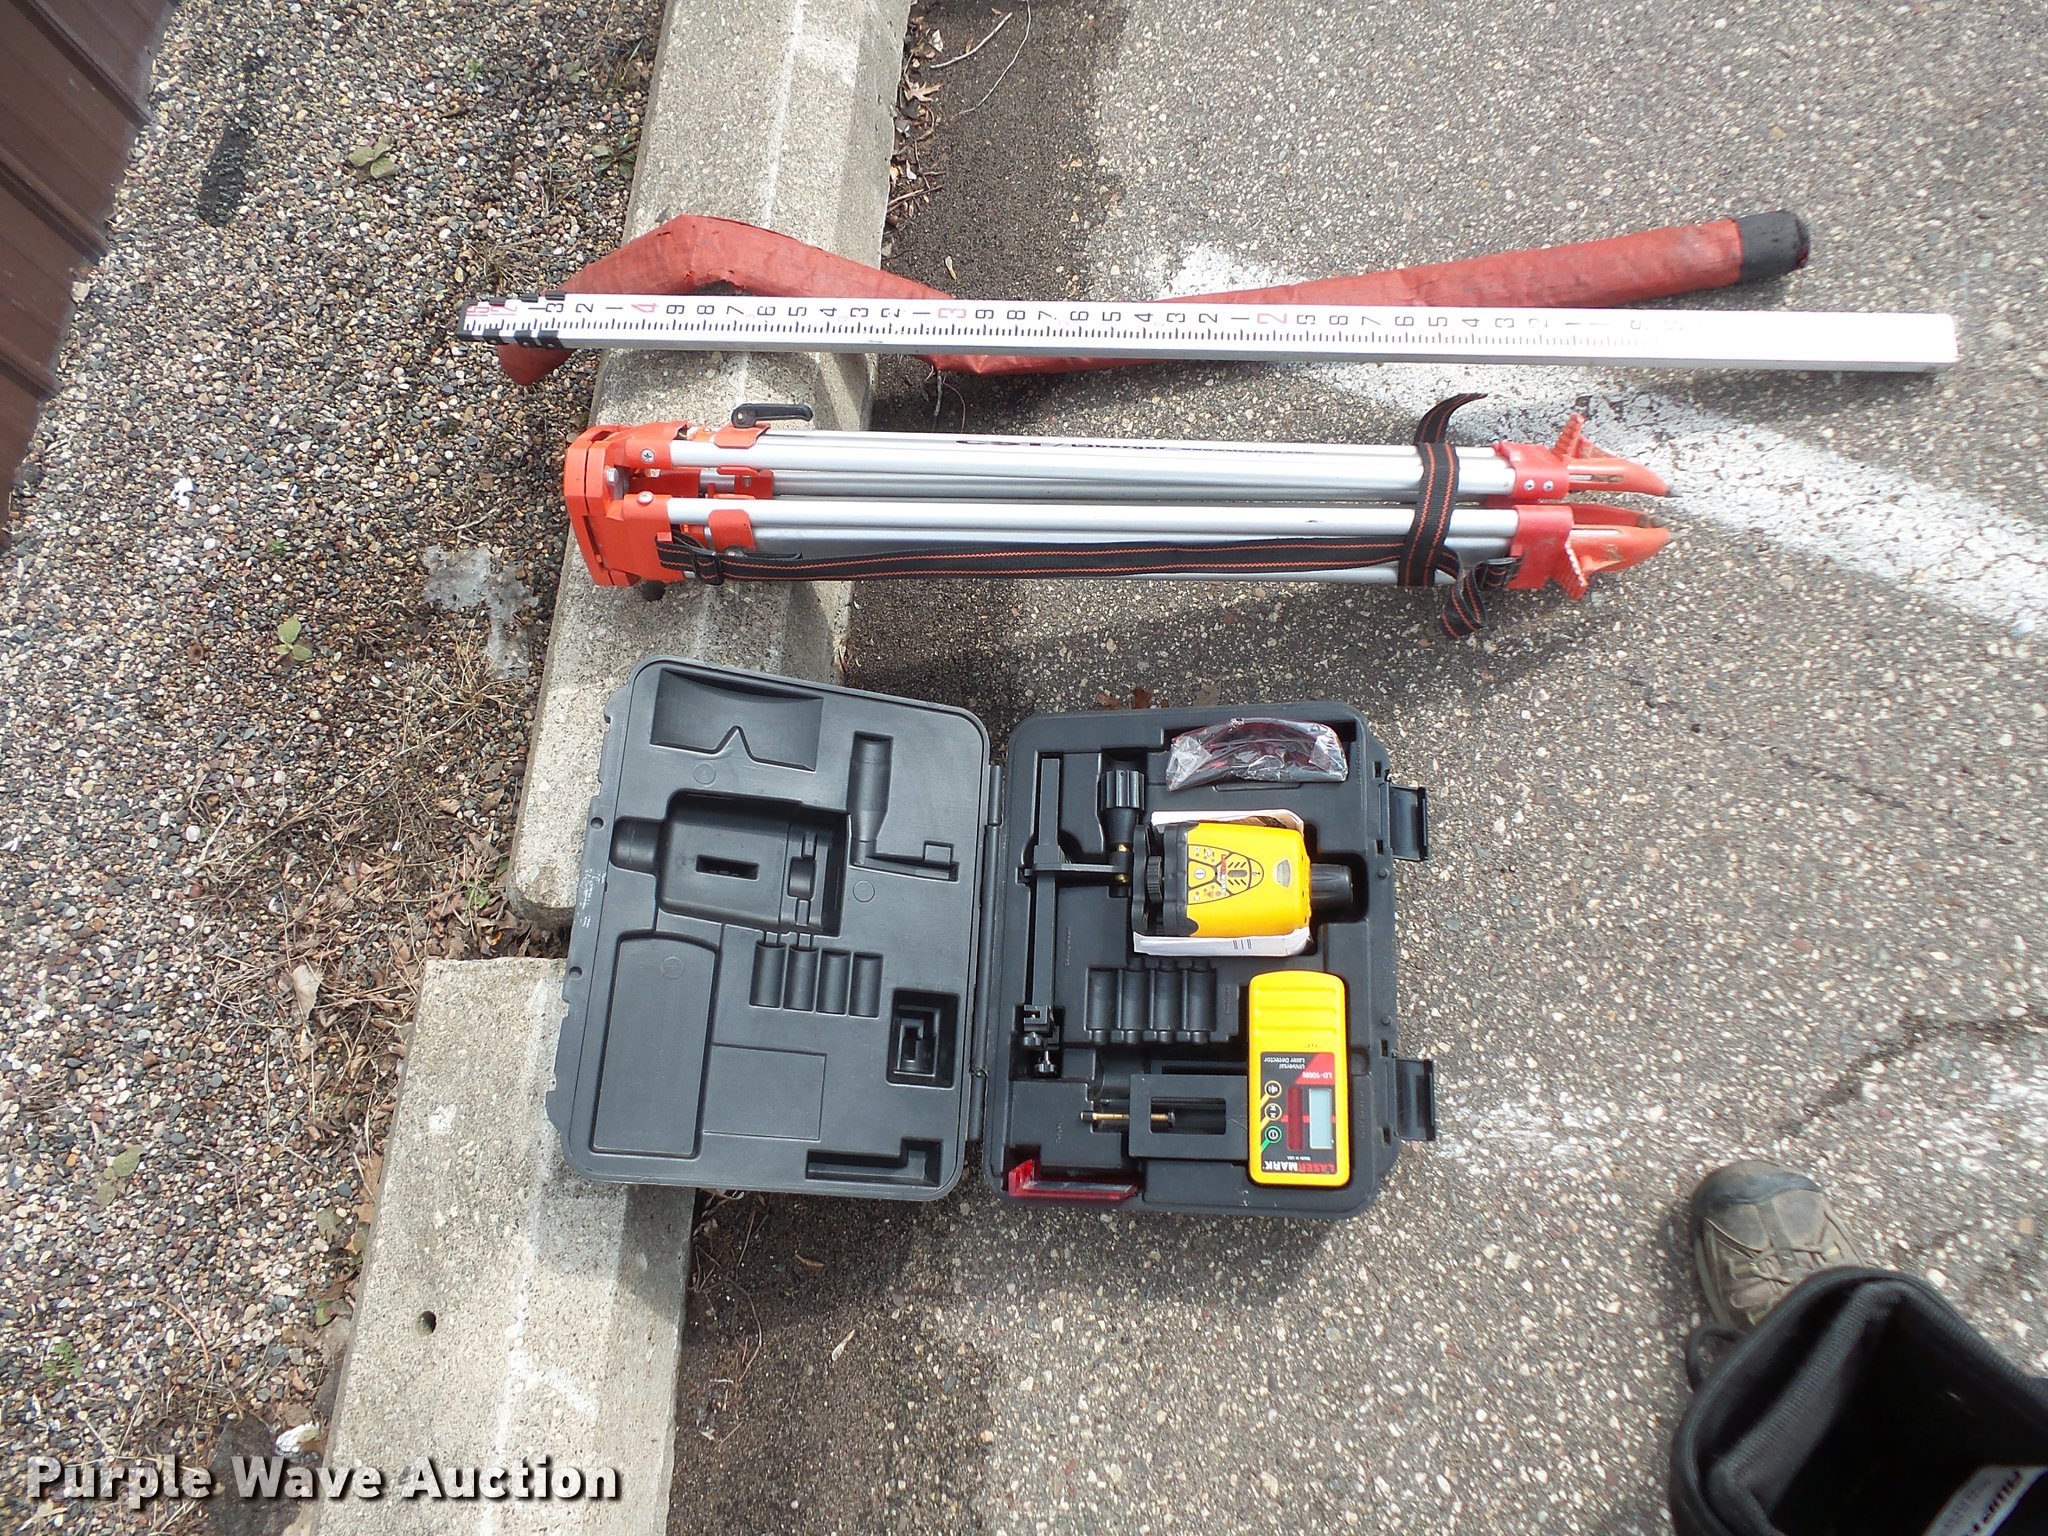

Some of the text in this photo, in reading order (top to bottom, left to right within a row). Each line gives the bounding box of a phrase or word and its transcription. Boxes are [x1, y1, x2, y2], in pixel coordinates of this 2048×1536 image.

[544, 302, 565, 314] 3
[575, 303, 594, 314] 2
[630, 302, 659, 314] 4
[665, 304, 685, 315] 9
[696, 304, 715, 315] 8
[726, 305, 745, 315] 7
[787, 306, 808, 317] 5
[819, 307, 838, 317] 4
[849, 307, 869, 318] 3
[937, 307, 968, 319] 3
[975, 309, 995, 320] 9
[1006, 309, 1026, 321] 8
[1037, 310, 1057, 321] 7
[1069, 310, 1090, 322] 6
[1101, 311, 1122, 322] 5
[1134, 312, 1154, 323] 4
[1166, 312, 1186, 323] 3
[1198, 313, 1218, 324] 2
[1256, 312, 1288, 325] 2
[1328, 314, 1349, 326] 8
[1361, 315, 1381, 326] 7
[1394, 315, 1415, 327] 6
[1428, 316, 1448, 327] 5
[1461, 318, 1480, 328] 4
[1494, 317, 1515, 329] 3
